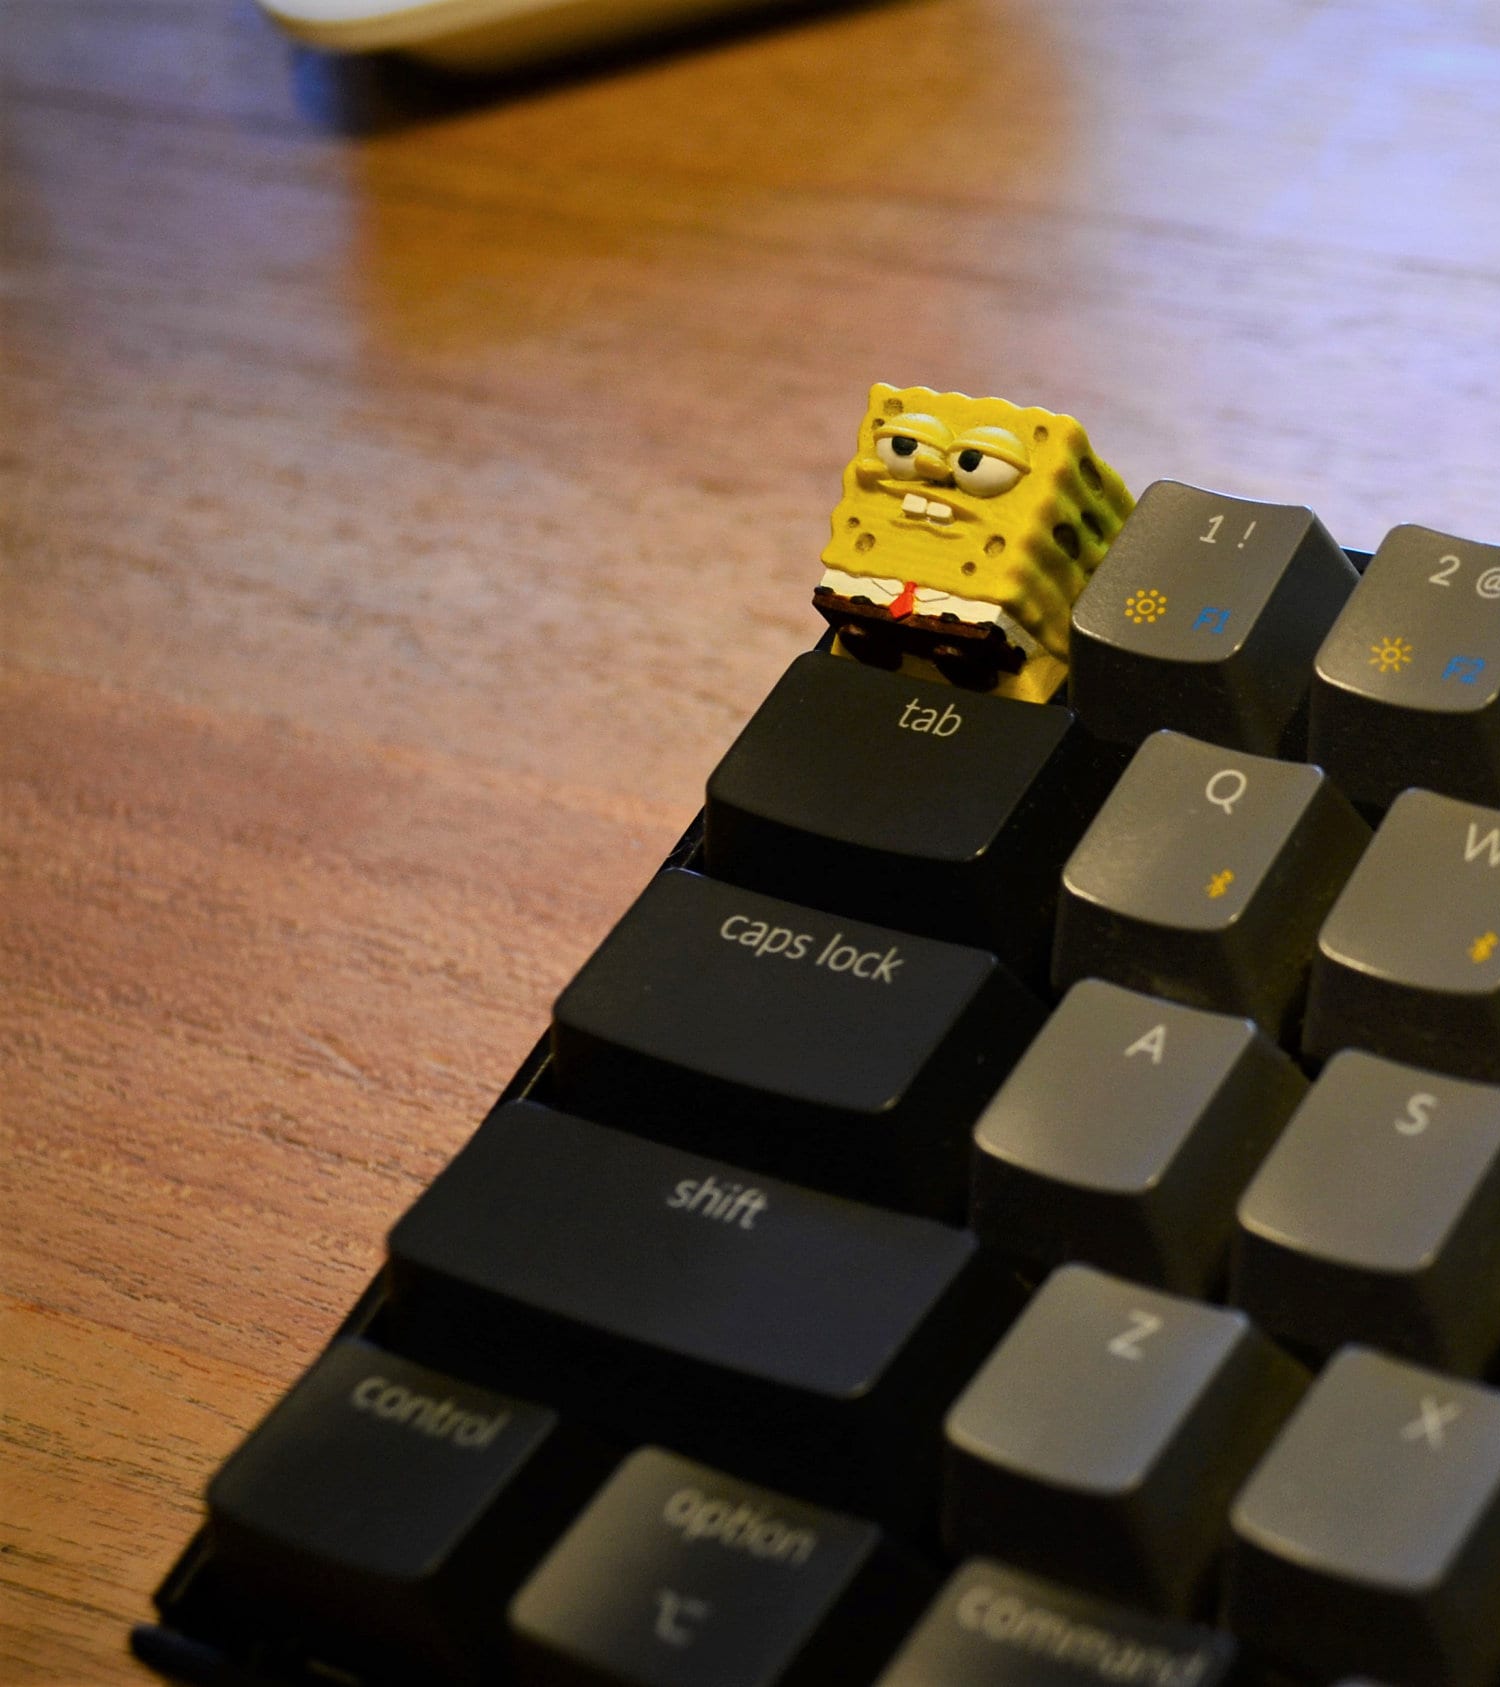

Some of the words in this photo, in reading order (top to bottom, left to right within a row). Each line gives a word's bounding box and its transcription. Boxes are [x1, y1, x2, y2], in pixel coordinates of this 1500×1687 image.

[1199, 515, 1225, 544] 1
[1236, 520, 1257, 549] !
[1428, 555, 1461, 587] 2
[1193, 606, 1232, 635] F1
[1441, 654, 1487, 684] F2
[897, 696, 963, 739] tab
[1205, 769, 1248, 815] Q
[720, 912, 810, 961] caps
[815, 932, 905, 985] lock
[1123, 1024, 1169, 1066] A
[1394, 1093, 1438, 1136] S
[666, 1174, 769, 1230] shift
[1107, 1310, 1163, 1362] Z
[352, 1374, 511, 1449] control
[1401, 1396, 1459, 1452] X
[661, 1488, 819, 1565] option
